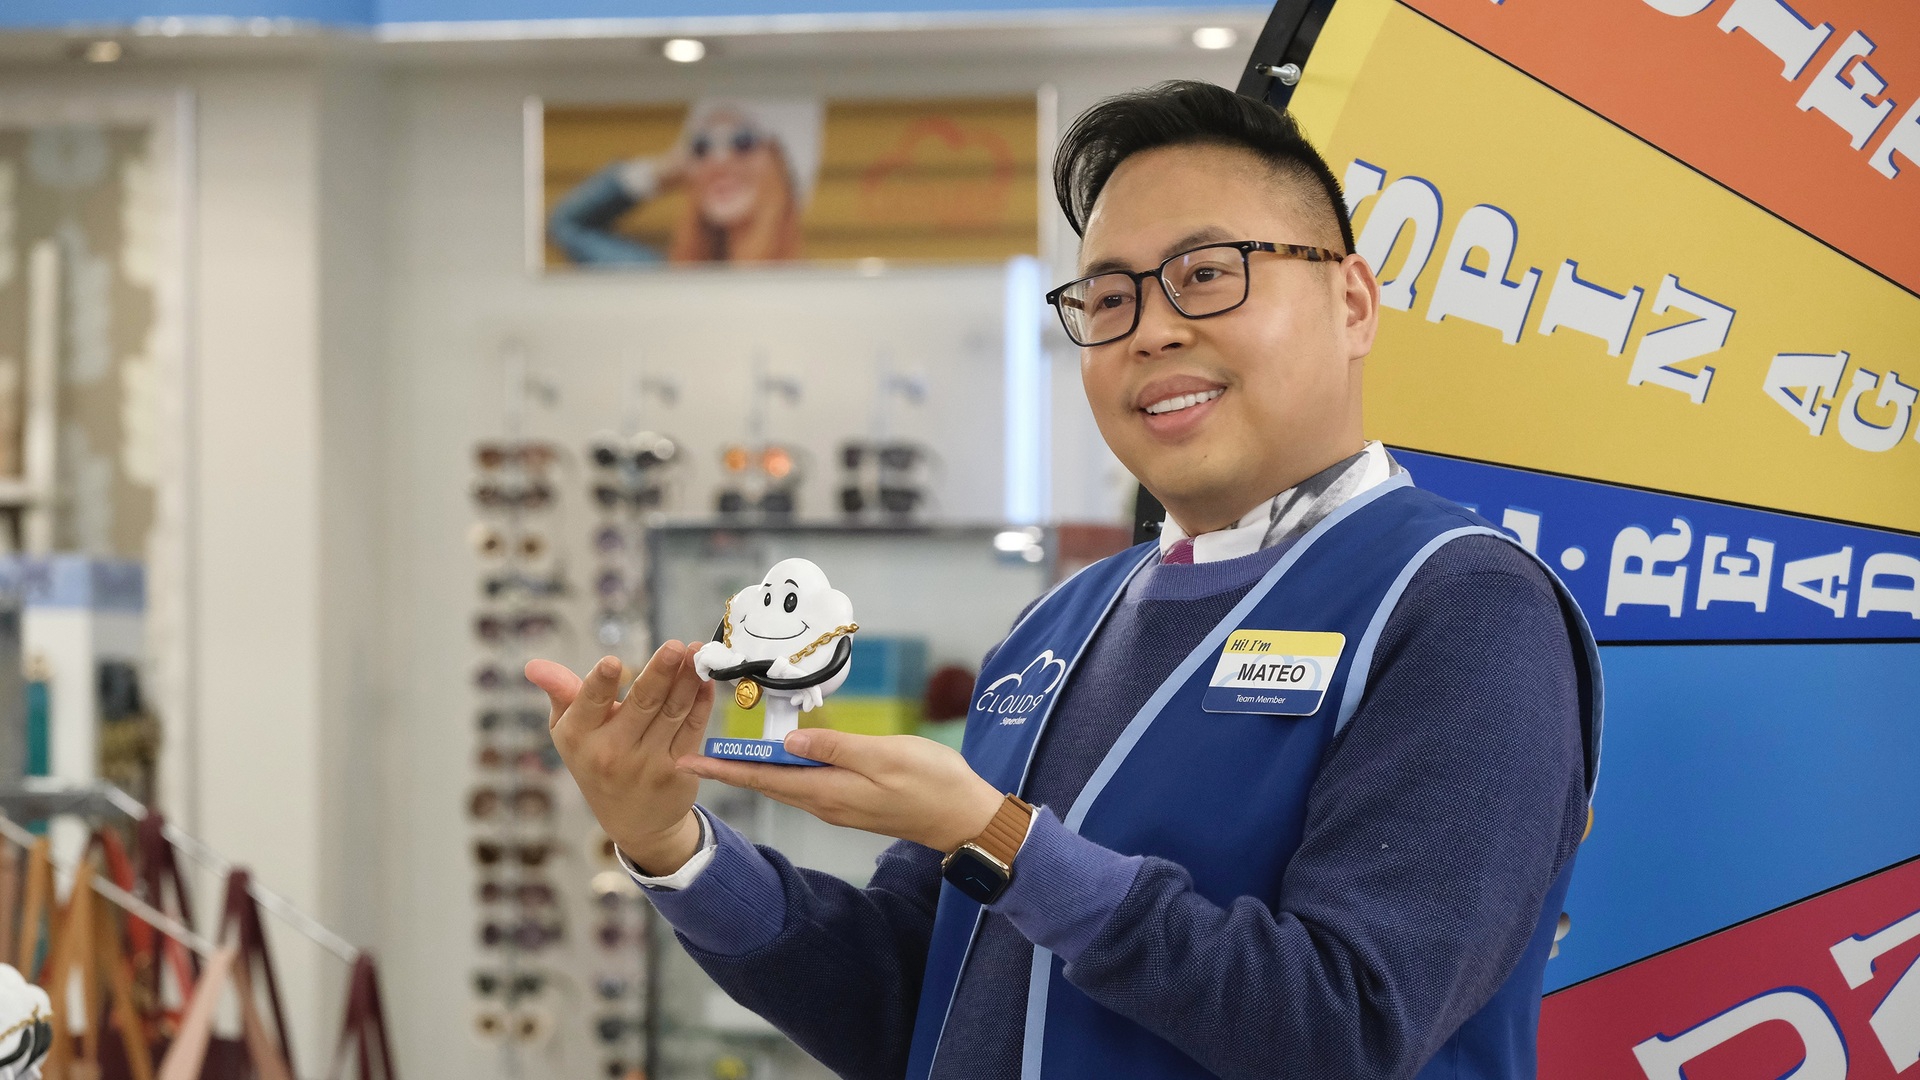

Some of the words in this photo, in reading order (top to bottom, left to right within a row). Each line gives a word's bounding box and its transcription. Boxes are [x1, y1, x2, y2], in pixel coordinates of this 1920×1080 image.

[1343, 158, 1737, 405] SPIN
[1762, 350, 1920, 452] AG
[1230, 639, 1249, 651] Hi!
[1249, 639, 1272, 652] I'm
[1237, 663, 1306, 683] MATEO
[1236, 694, 1255, 703] Team
[1255, 695, 1286, 704] Member
[712, 742, 723, 754] MC
[723, 743, 743, 755] COOL
[744, 744, 773, 758] CLOUD
